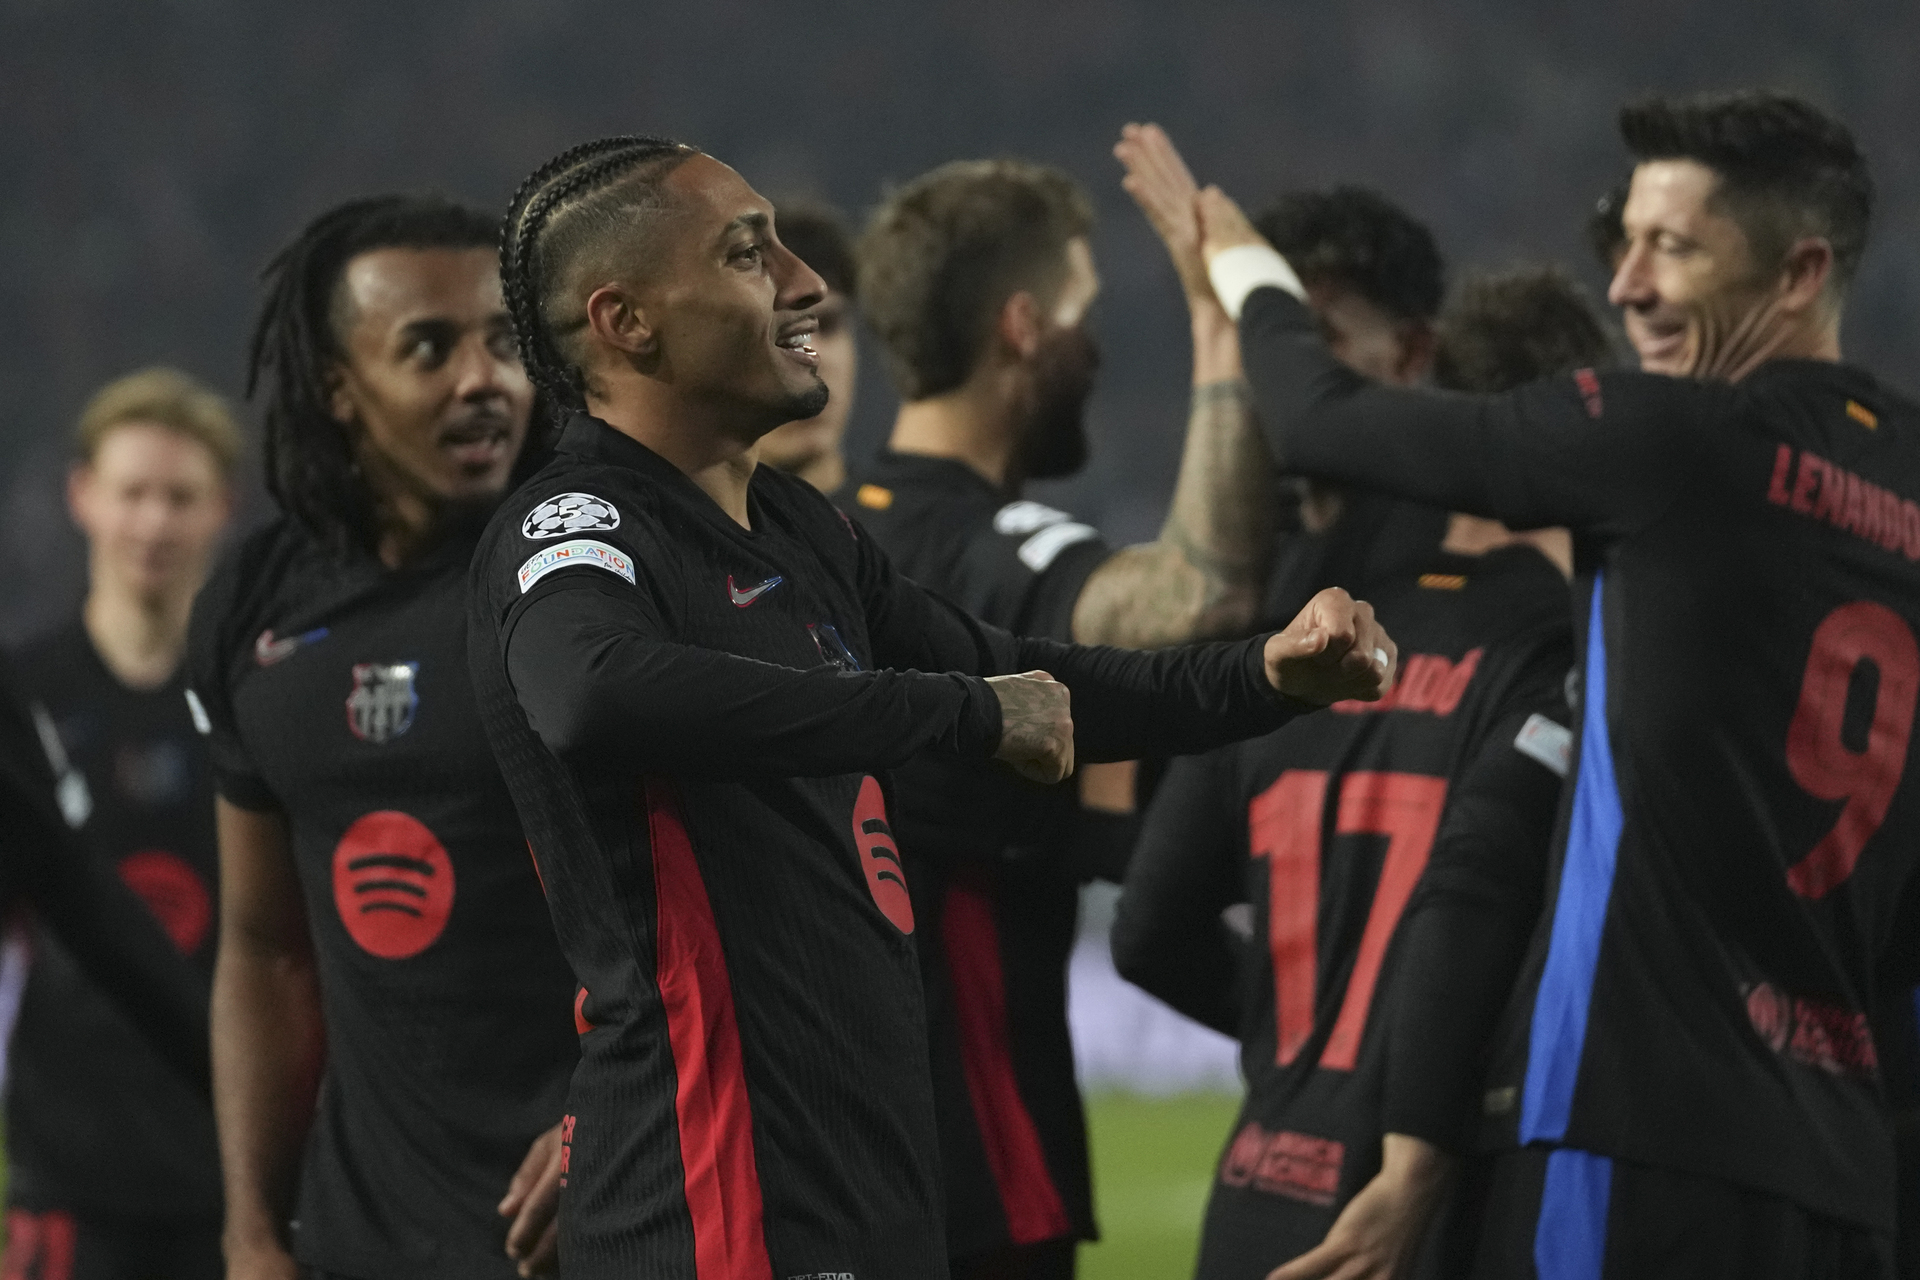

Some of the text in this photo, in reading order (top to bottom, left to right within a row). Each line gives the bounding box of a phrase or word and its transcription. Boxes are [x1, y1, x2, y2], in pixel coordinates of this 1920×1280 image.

[522, 547, 634, 582] FOUNDATION
[1786, 600, 1920, 899] 9
[1248, 768, 1449, 1072] 17
